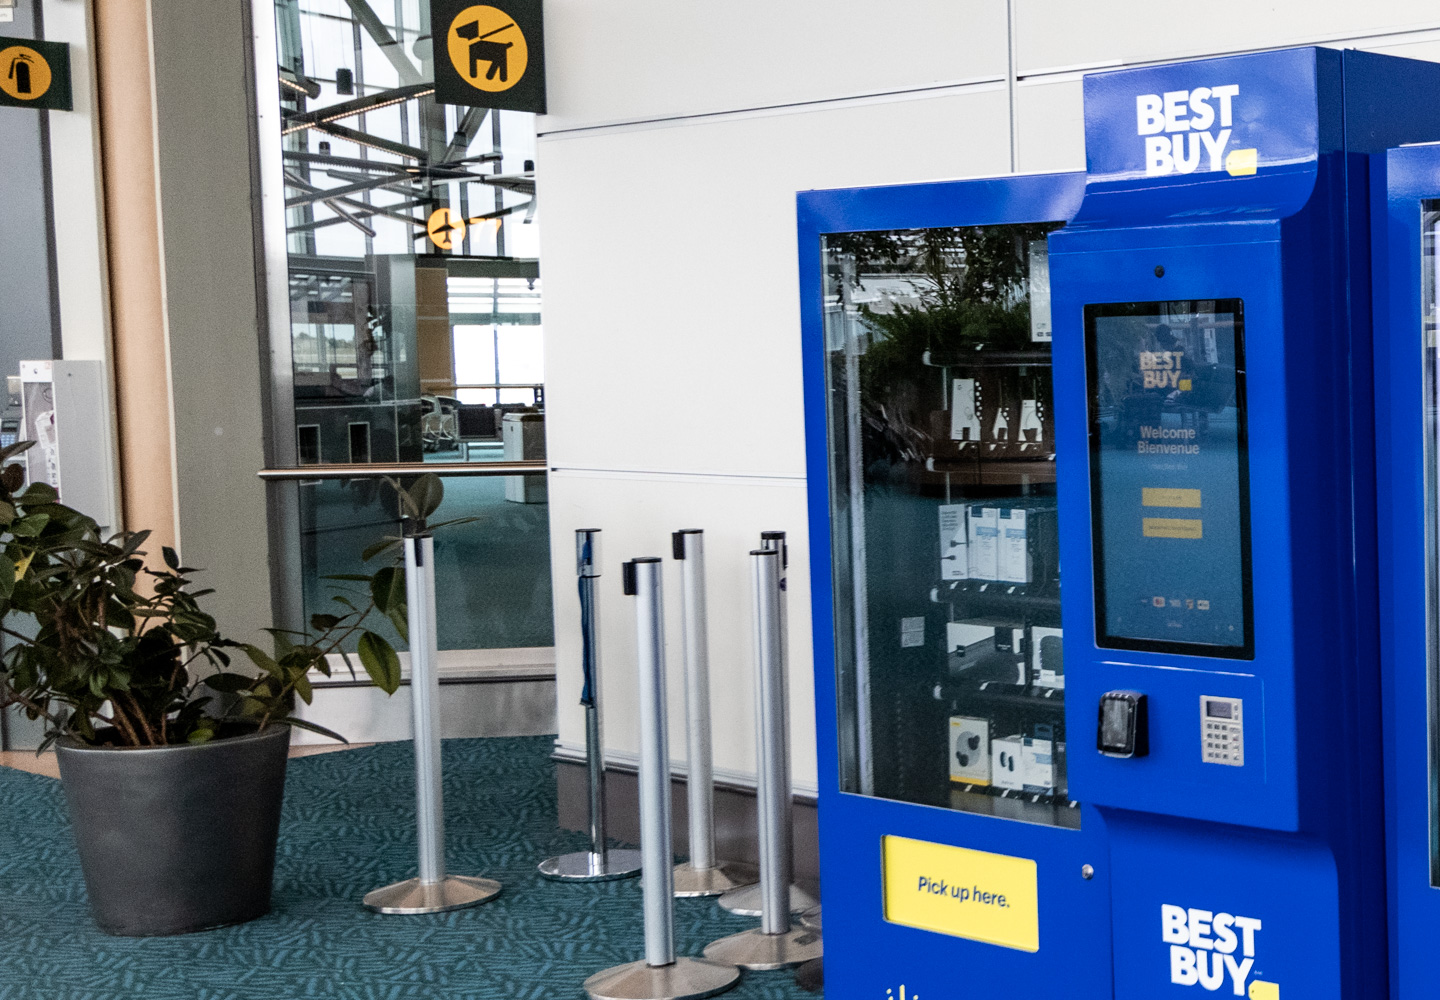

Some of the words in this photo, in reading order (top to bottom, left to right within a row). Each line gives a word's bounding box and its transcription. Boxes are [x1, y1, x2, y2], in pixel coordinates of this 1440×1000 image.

[1136, 84, 1239, 136] BEST
[1145, 129, 1232, 177] BUY
[1139, 351, 1184, 370] BEST
[1143, 370, 1181, 389] BUY
[1137, 440, 1200, 455] Bienvenue
[1140, 426, 1196, 439] Welcome
[918, 876, 949, 897] Pick
[951, 885, 970, 903] up
[973, 885, 1010, 908] here.
[1161, 903, 1262, 957] BEST
[1170, 944, 1255, 997] BUY
